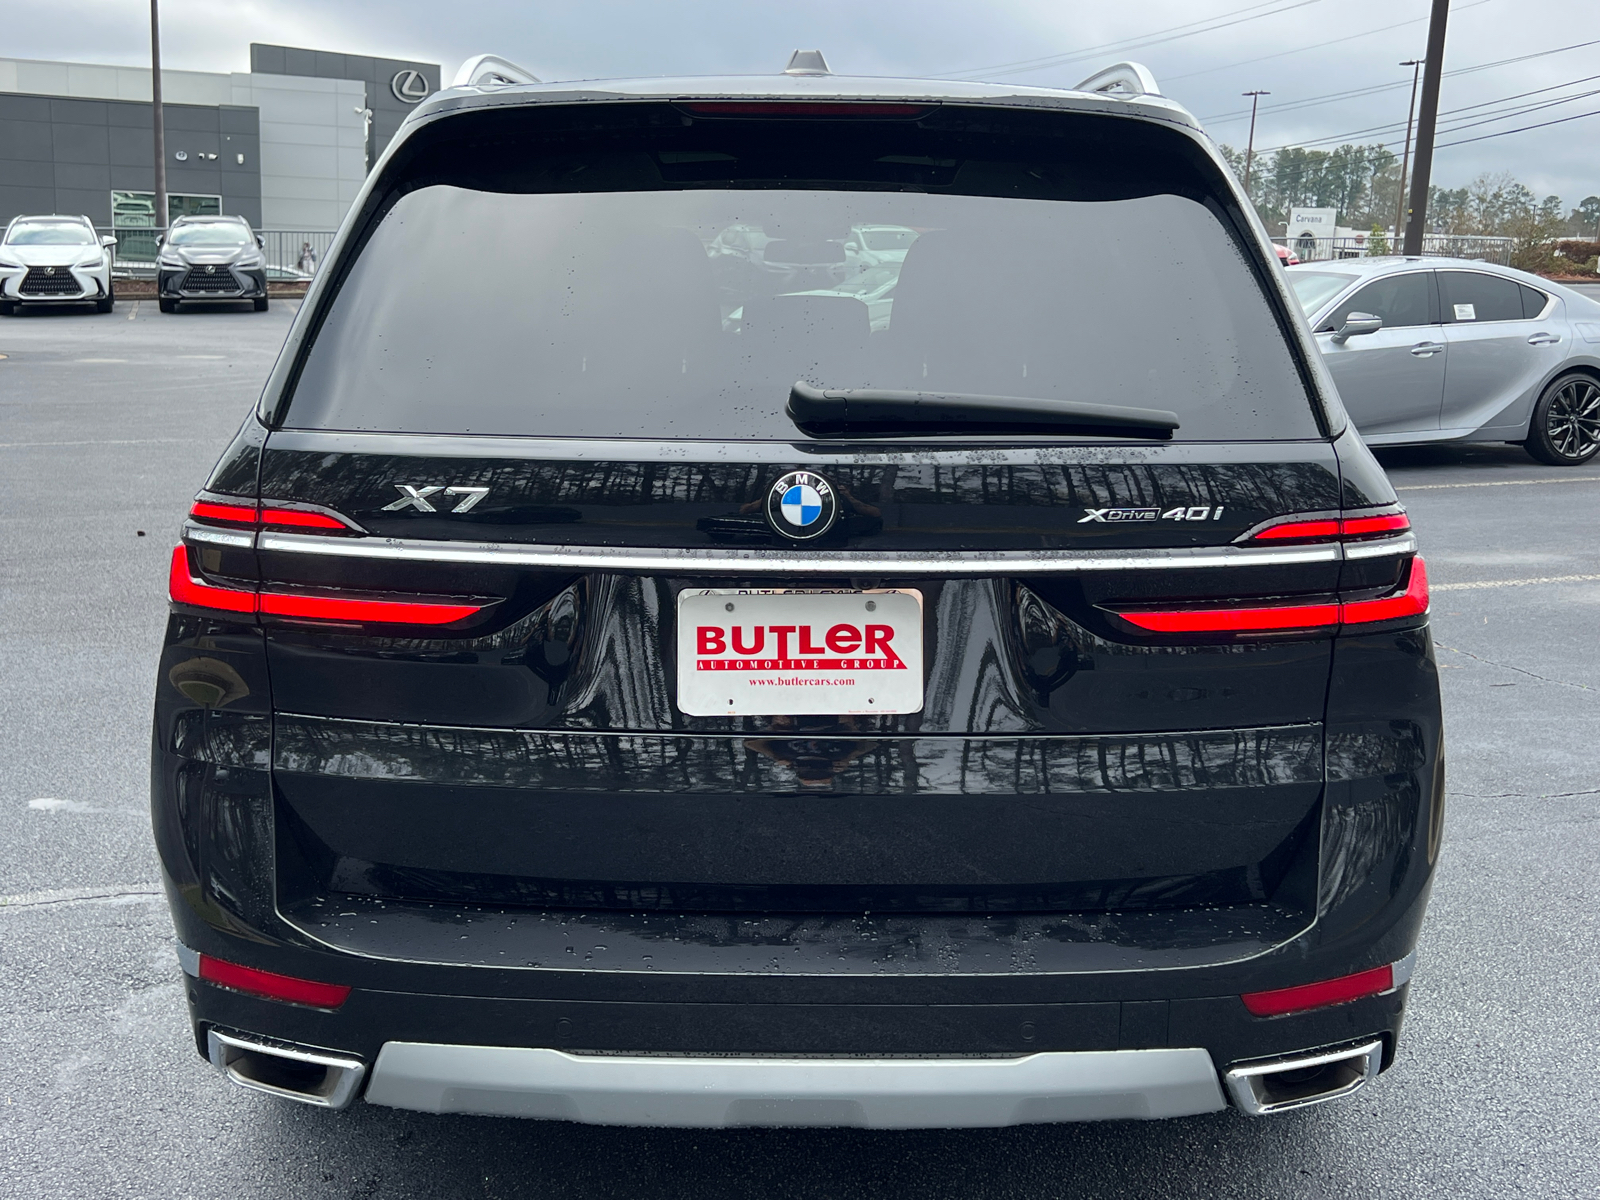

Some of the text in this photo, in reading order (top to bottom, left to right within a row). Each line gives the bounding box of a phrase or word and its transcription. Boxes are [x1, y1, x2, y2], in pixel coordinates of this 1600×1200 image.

[1295, 214, 1322, 223] Carvana
[775, 474, 829, 495] BMW
[381, 485, 490, 513] X7
[1162, 506, 1225, 521] 40i
[697, 659, 901, 670] AUTOMOTIVE GROUP
[748, 676, 855, 687] www.butlercars.com
